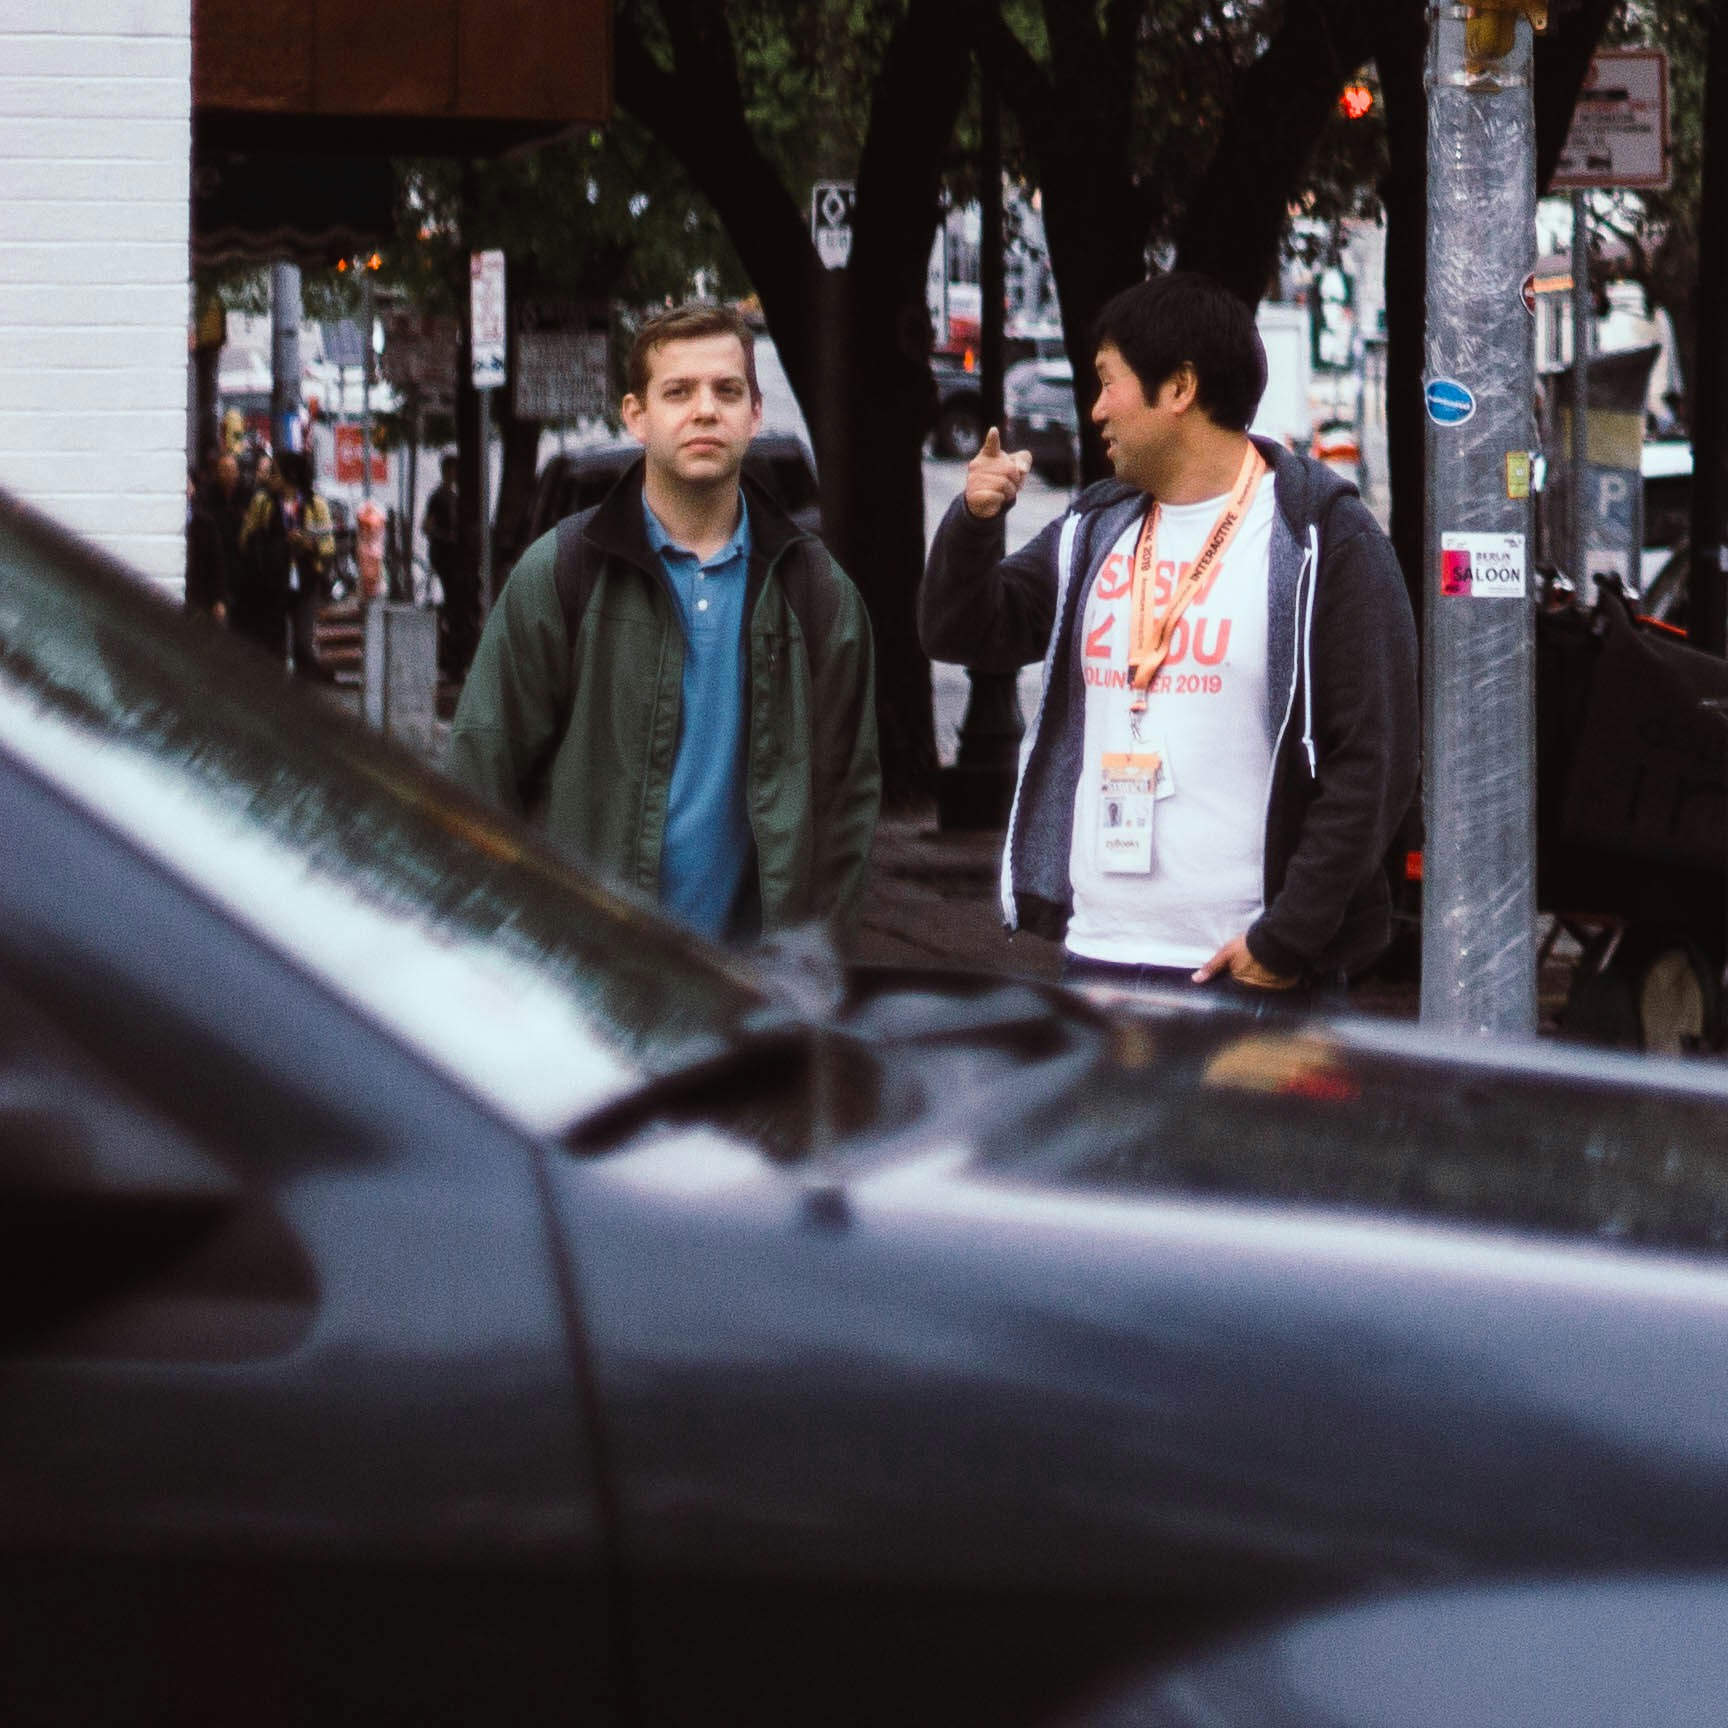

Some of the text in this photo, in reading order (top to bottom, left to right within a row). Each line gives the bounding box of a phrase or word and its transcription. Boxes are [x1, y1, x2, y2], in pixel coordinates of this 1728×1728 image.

[1190, 511, 1238, 581] INTERACTIVE
[1475, 552, 1511, 562] BERLIN
[1453, 566, 1520, 583] SALOON
[1176, 674, 1223, 694] 2019
